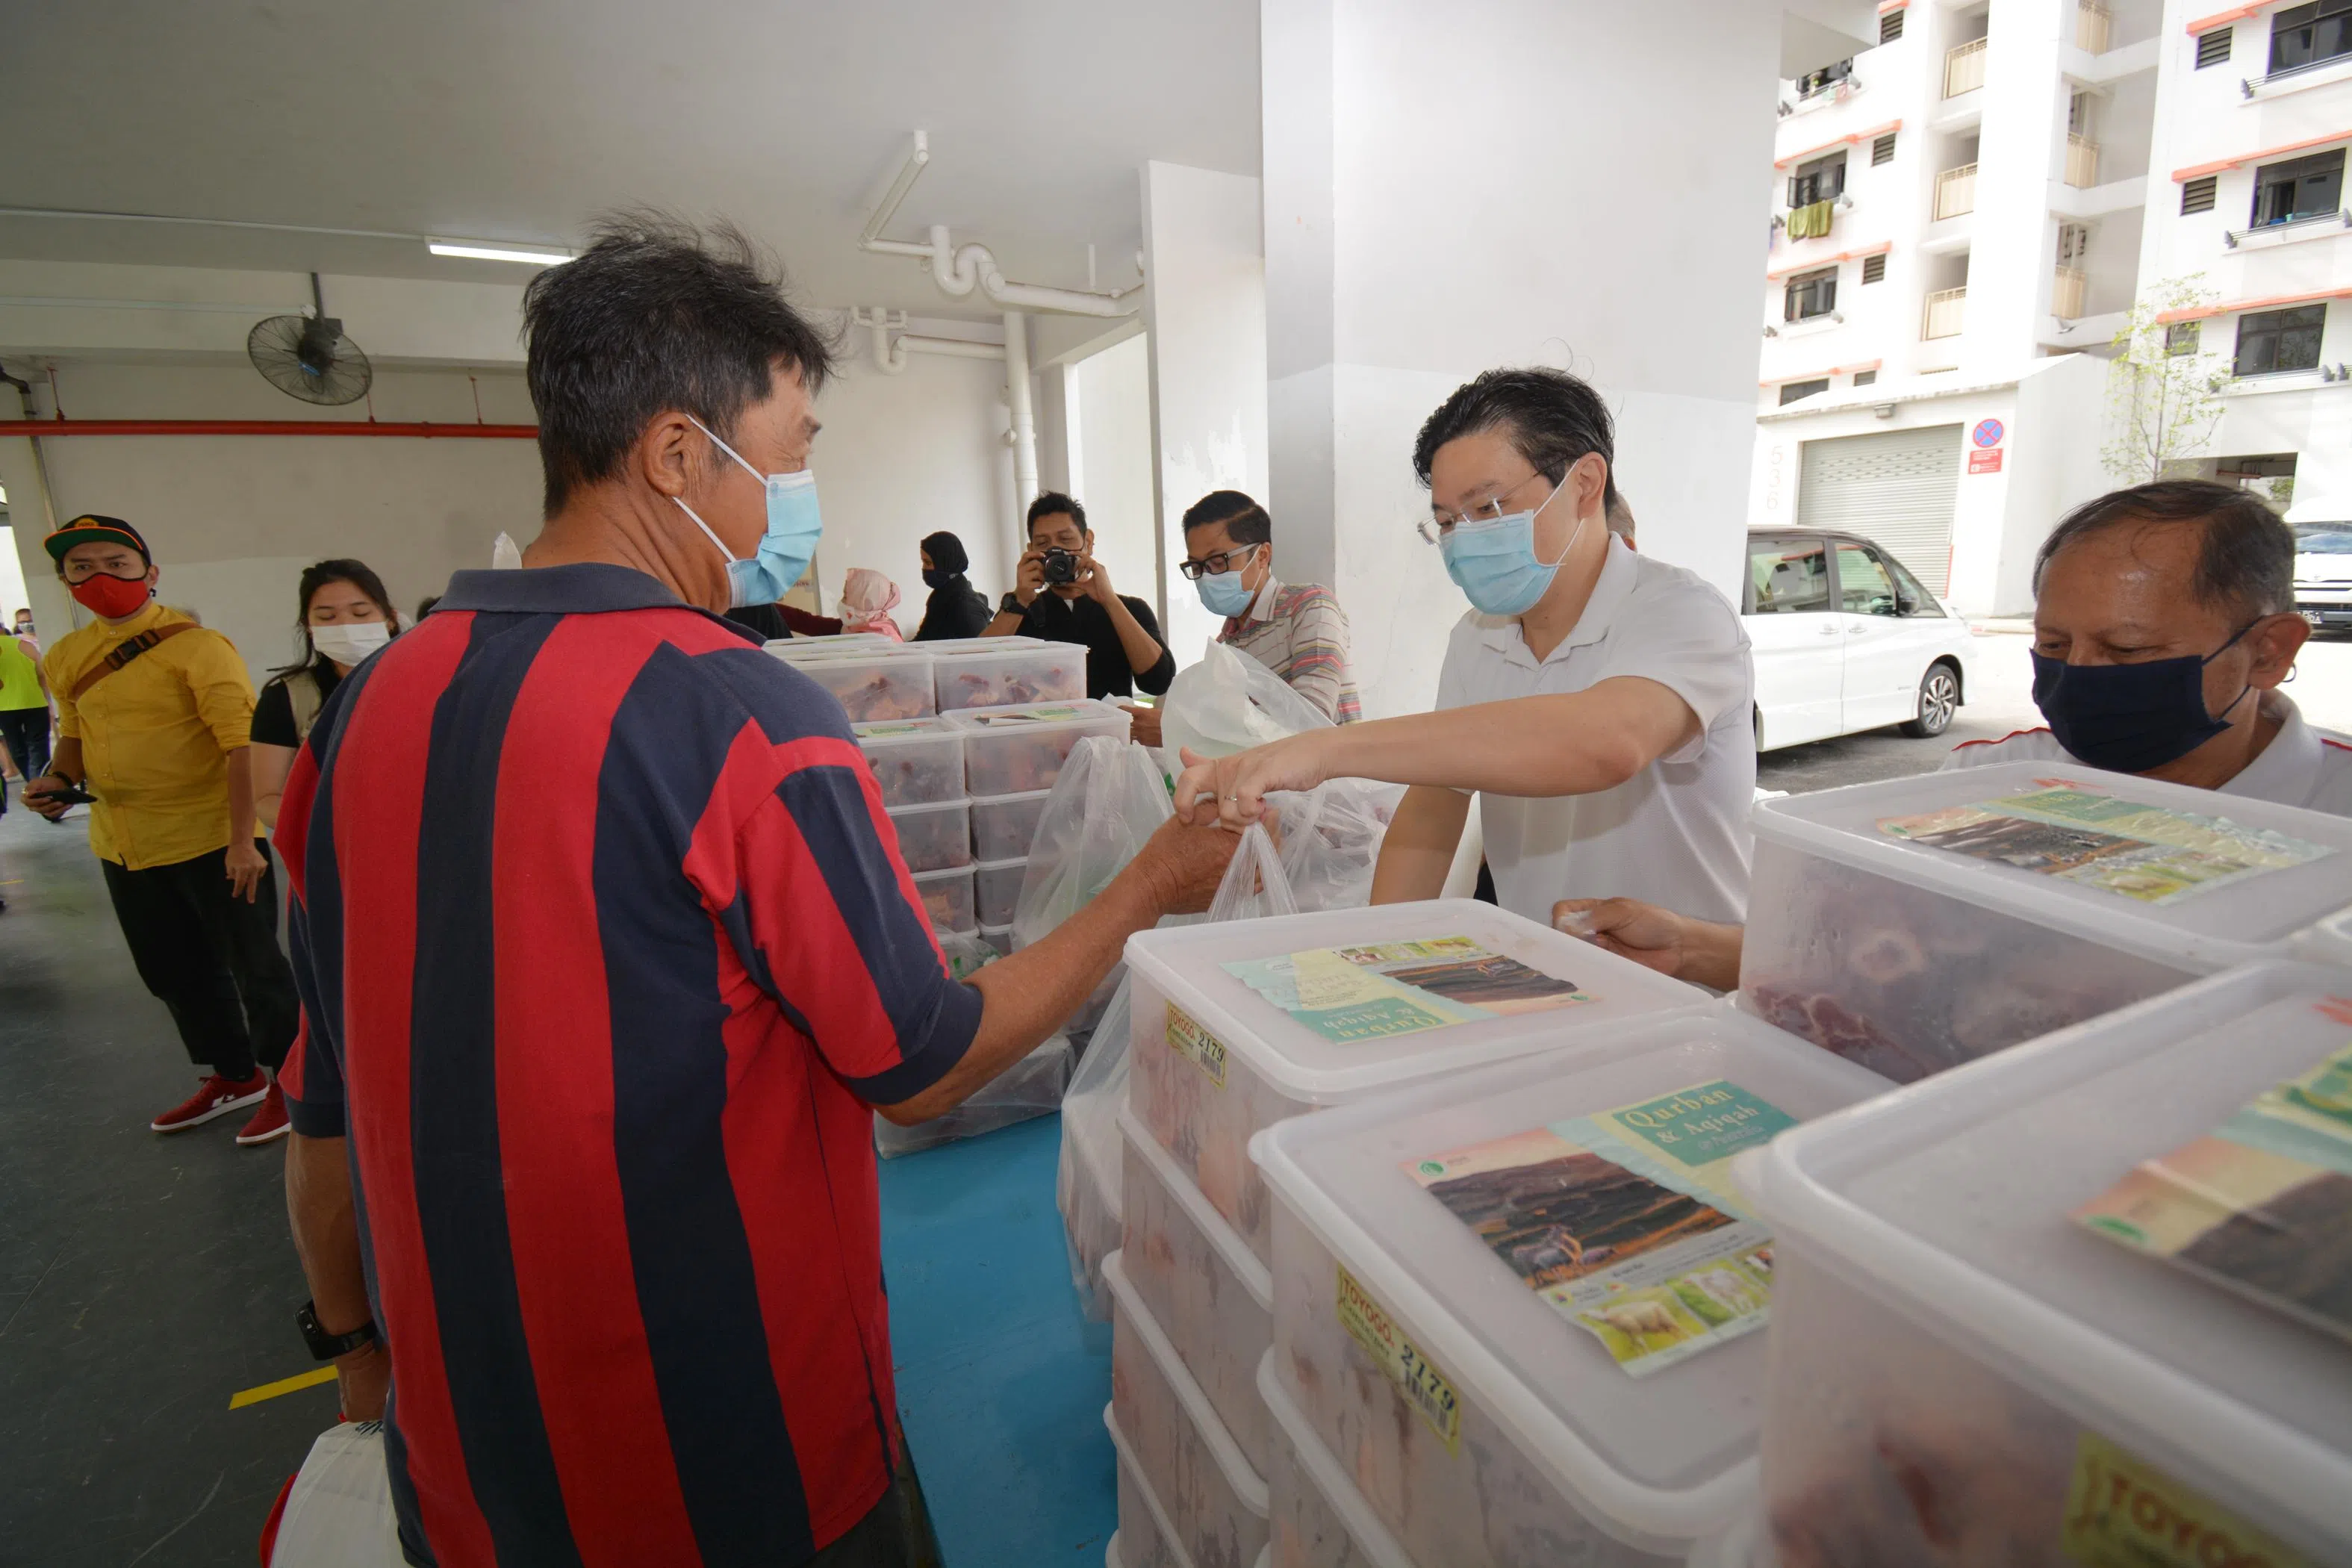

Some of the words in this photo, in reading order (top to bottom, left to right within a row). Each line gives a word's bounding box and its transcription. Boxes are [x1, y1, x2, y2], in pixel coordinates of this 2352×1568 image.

[1170, 1009, 1195, 1039] TOYOGO
[1198, 1031, 1225, 1063] 2179
[1323, 1009, 1392, 1030] Aqiqah
[1338, 1015, 1437, 1038] Qurban
[1624, 1089, 1735, 1128] Qurban
[1655, 1129, 1684, 1144] &
[1684, 1104, 1760, 1136] Aqiqah
[1343, 1278, 1393, 1343] TOYOGO
[1400, 1343, 1455, 1411] 2179
